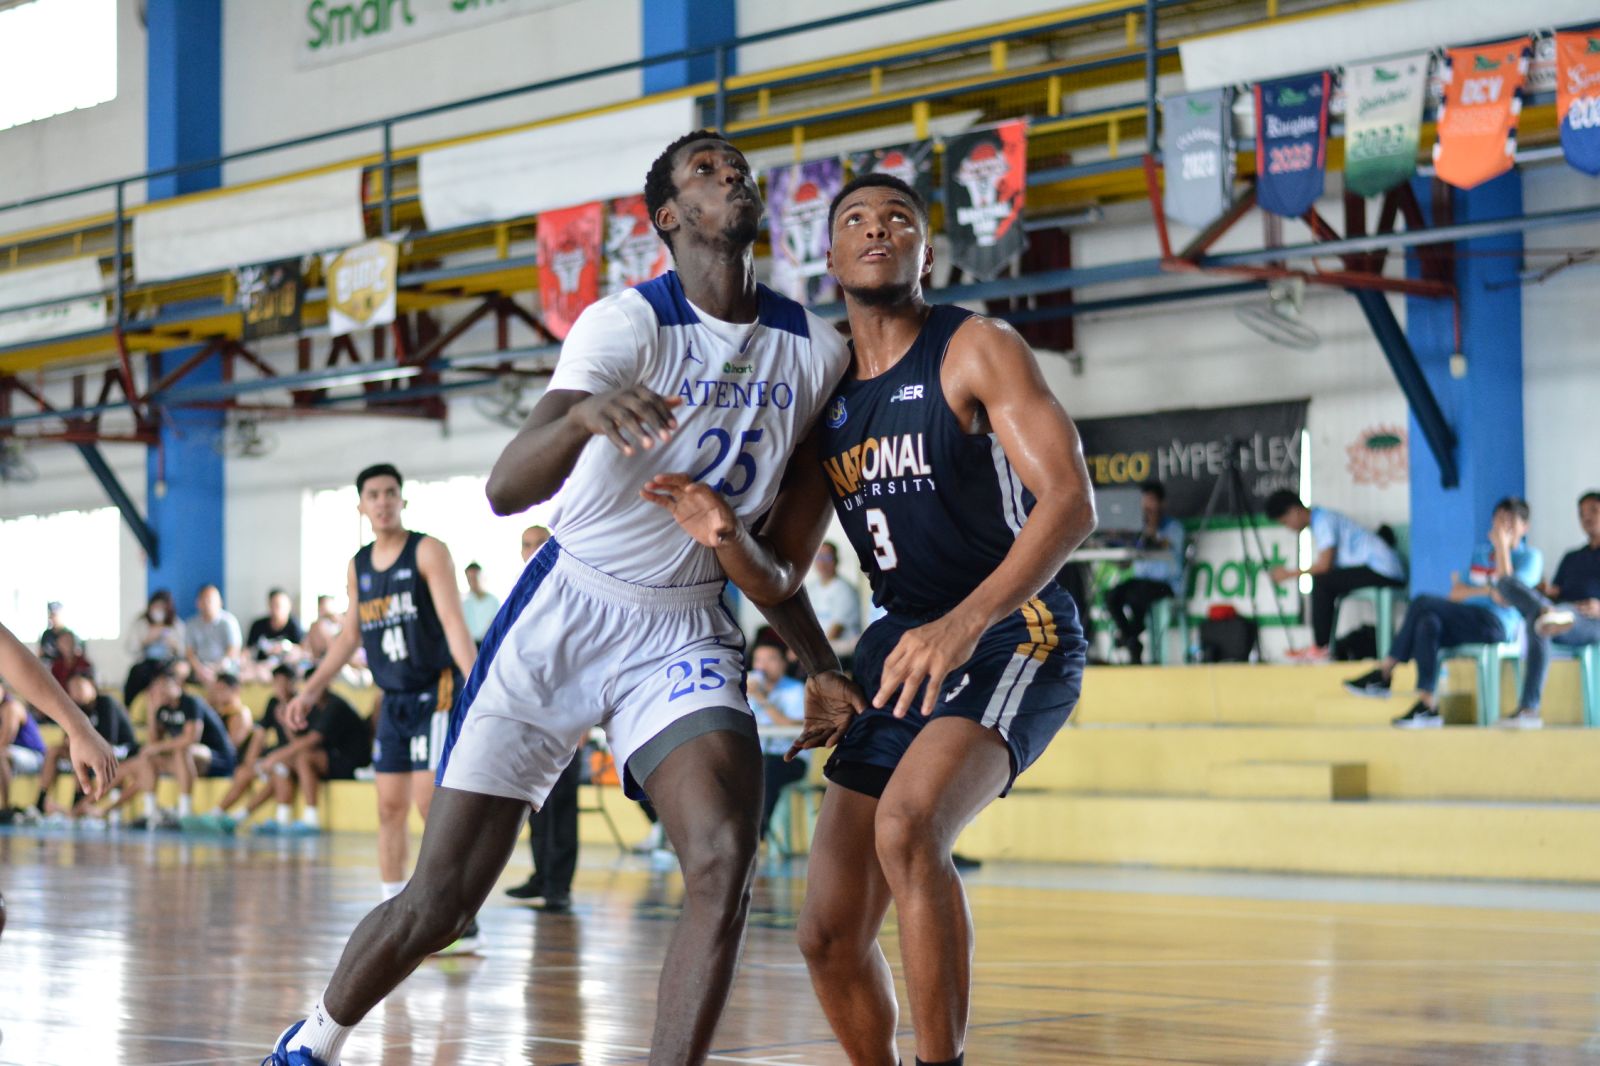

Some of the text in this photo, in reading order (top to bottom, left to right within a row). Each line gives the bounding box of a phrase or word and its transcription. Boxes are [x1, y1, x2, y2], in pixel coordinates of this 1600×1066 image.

[678, 378, 793, 410] ATENEO
[693, 427, 764, 497] 25
[823, 433, 932, 498] NATONAL
[866, 507, 898, 571] 3
[666, 657, 727, 703] 25
